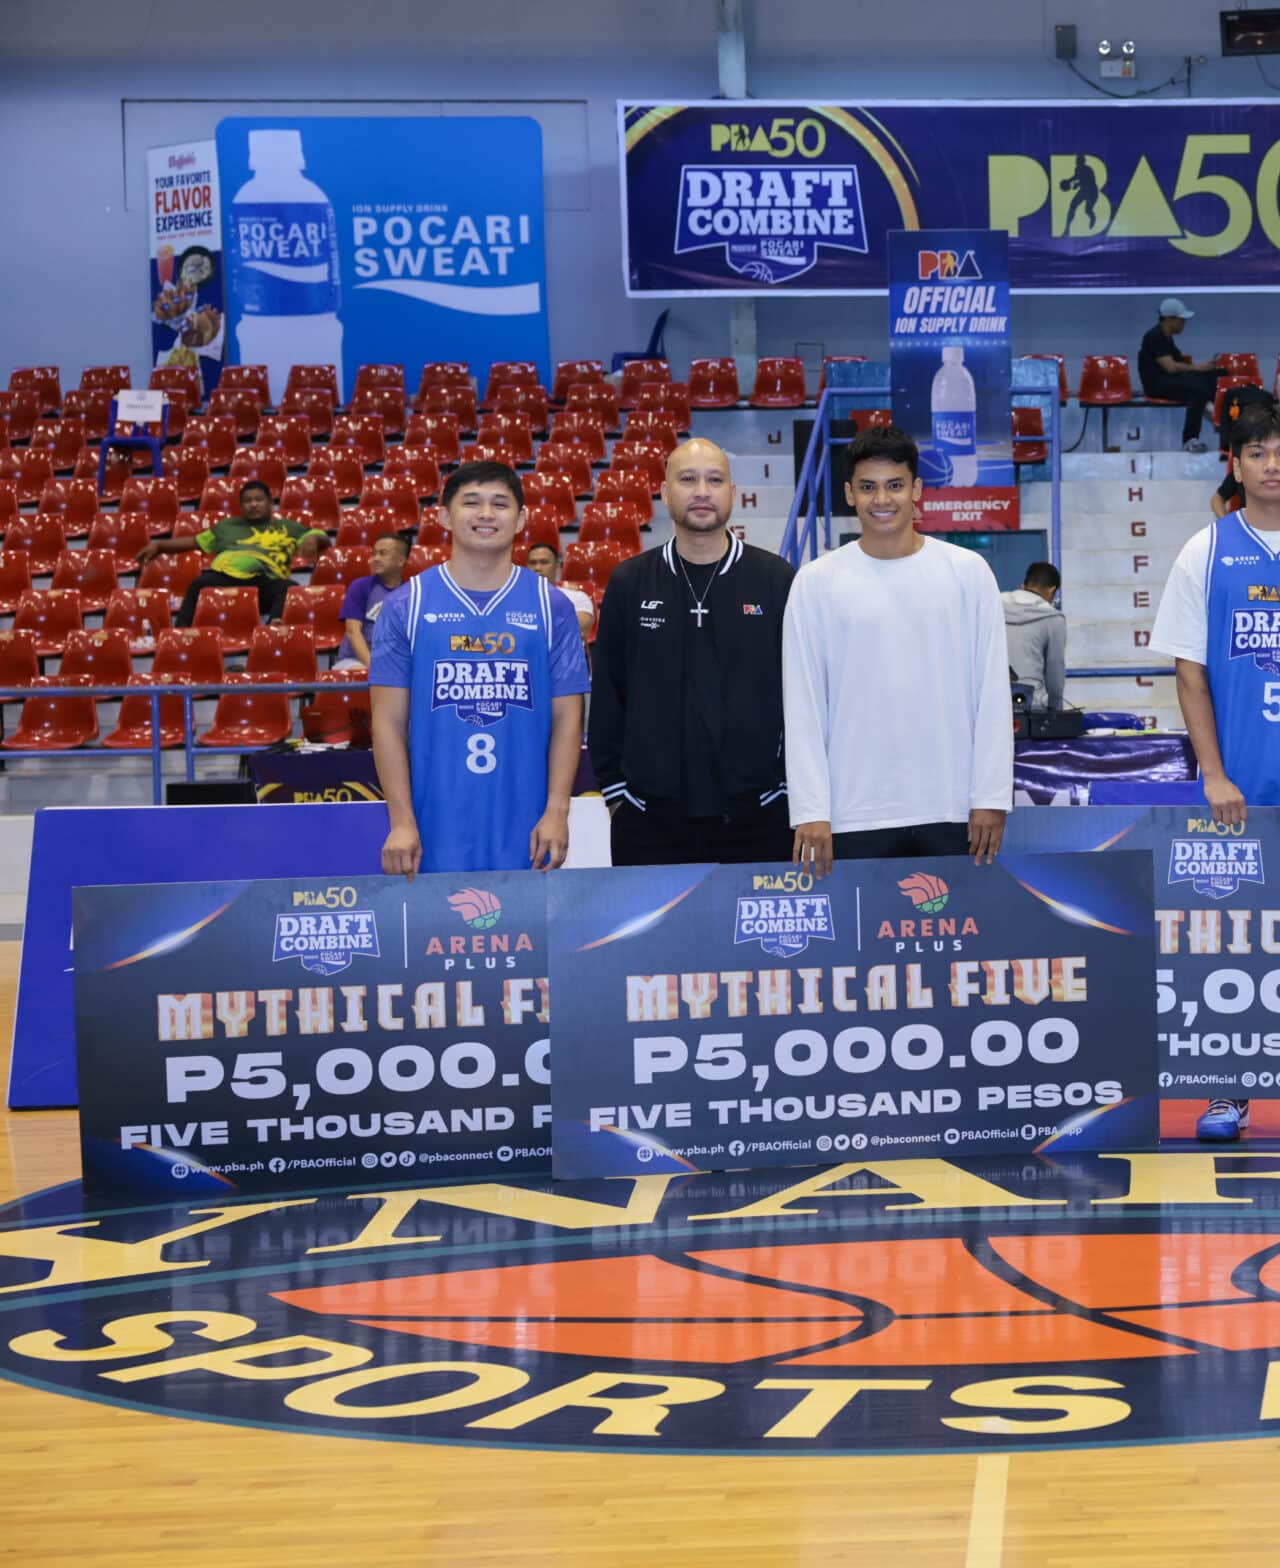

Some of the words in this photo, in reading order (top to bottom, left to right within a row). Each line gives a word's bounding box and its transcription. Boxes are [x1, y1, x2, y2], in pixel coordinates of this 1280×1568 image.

[155, 175, 174, 189] YOUR
[175, 170, 210, 186] FAVORITE
[686, 170, 853, 208] DRAFT
[155, 184, 211, 215] FLAVOR
[352, 204, 371, 213] ION
[375, 204, 414, 213] SUPPLY
[416, 203, 449, 212] DRINK
[156, 210, 212, 233] EXPERIENCE
[353, 215, 530, 246] POCARI
[687, 208, 855, 236] COMBINE
[239, 222, 327, 242] POCARI
[240, 239, 319, 258] SWEAT
[761, 240, 804, 249] POCARI
[354, 246, 515, 277] SWEAT
[903, 285, 996, 314] OFFICIAL
[895, 317, 918, 333] ION
[919, 317, 966, 333] SUPPLY
[968, 316, 1006, 332] DRINK
[741, 493, 757, 508] H
[1128, 487, 1143, 502] H
[923, 500, 1010, 511] EMERGENCY
[952, 511, 983, 521] EXIT
[1131, 521, 1147, 537] G
[1133, 555, 1149, 573] F
[1133, 591, 1150, 608] E
[436, 661, 528, 684] DRAFT
[436, 684, 528, 700] COMBINE
[466, 733, 496, 774] 8
[1174, 842, 1258, 860] DRAFT
[1175, 861, 1258, 875] COMBINE
[740, 897, 827, 920] DRAFT
[280, 914, 371, 936] DRAFT
[741, 917, 828, 934] COMBINE
[877, 918, 979, 938] ARENA
[280, 934, 372, 951] COMBINE
[425, 933, 533, 956] ARENA
[896, 939, 962, 953] PLUS
[445, 956, 516, 970] PLUS
[625, 962, 934, 1022] MYTHICAL
[947, 956, 1088, 1009] FIVE
[157, 981, 485, 1042] MYTHICAL
[633, 1017, 1080, 1092] P5,000.00
[1174, 1073, 1237, 1084] /PBAOfficial
[589, 1103, 691, 1133] FIVE
[709, 1089, 962, 1124] THOUSAND
[978, 1081, 1123, 1110] PESOS
[120, 1120, 229, 1150] FIVE
[247, 1105, 515, 1143] THOUSAND
[746, 1140, 811, 1153] /PBAOfficial
[871, 1134, 941, 1146] @pbaconnect
[961, 1128, 1019, 1140] PBAOfficial
[1038, 1126, 1057, 1136] PBA
[287, 1156, 356, 1170] /PBAOfficial
[419, 1150, 494, 1164] @pbaconnect
[515, 1146, 552, 1157] PBAOff
[8, 1310, 1132, 1437] SPORTS
